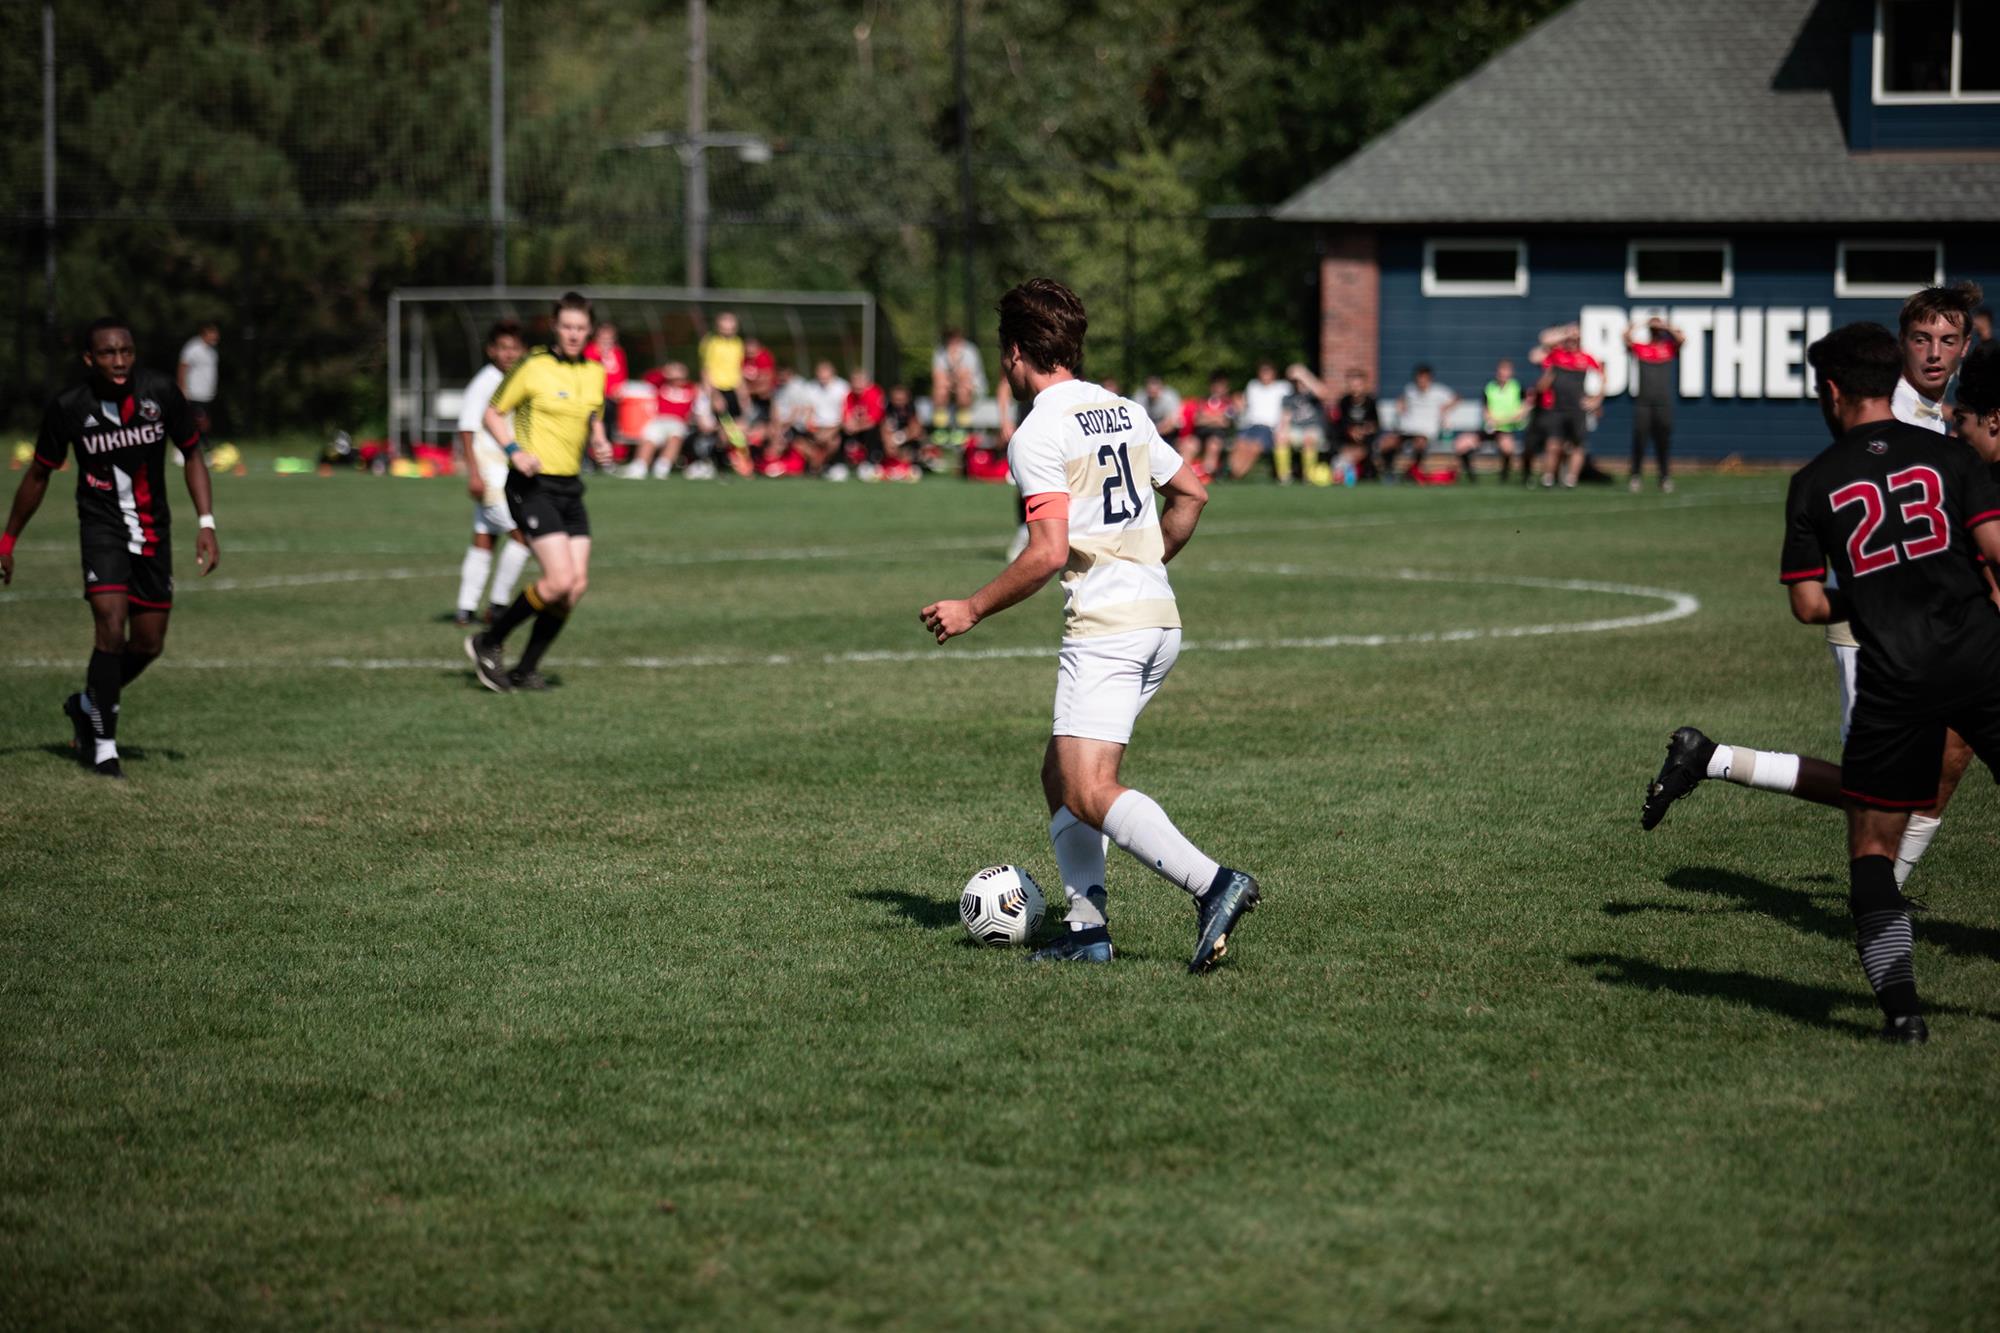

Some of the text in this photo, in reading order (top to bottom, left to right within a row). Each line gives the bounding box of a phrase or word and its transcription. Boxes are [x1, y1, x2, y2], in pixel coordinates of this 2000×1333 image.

[83, 422, 164, 454] VIKINGS
[1075, 406, 1132, 436] ROYALS
[1098, 442, 1142, 525] 21
[1829, 466, 1950, 577] 23
